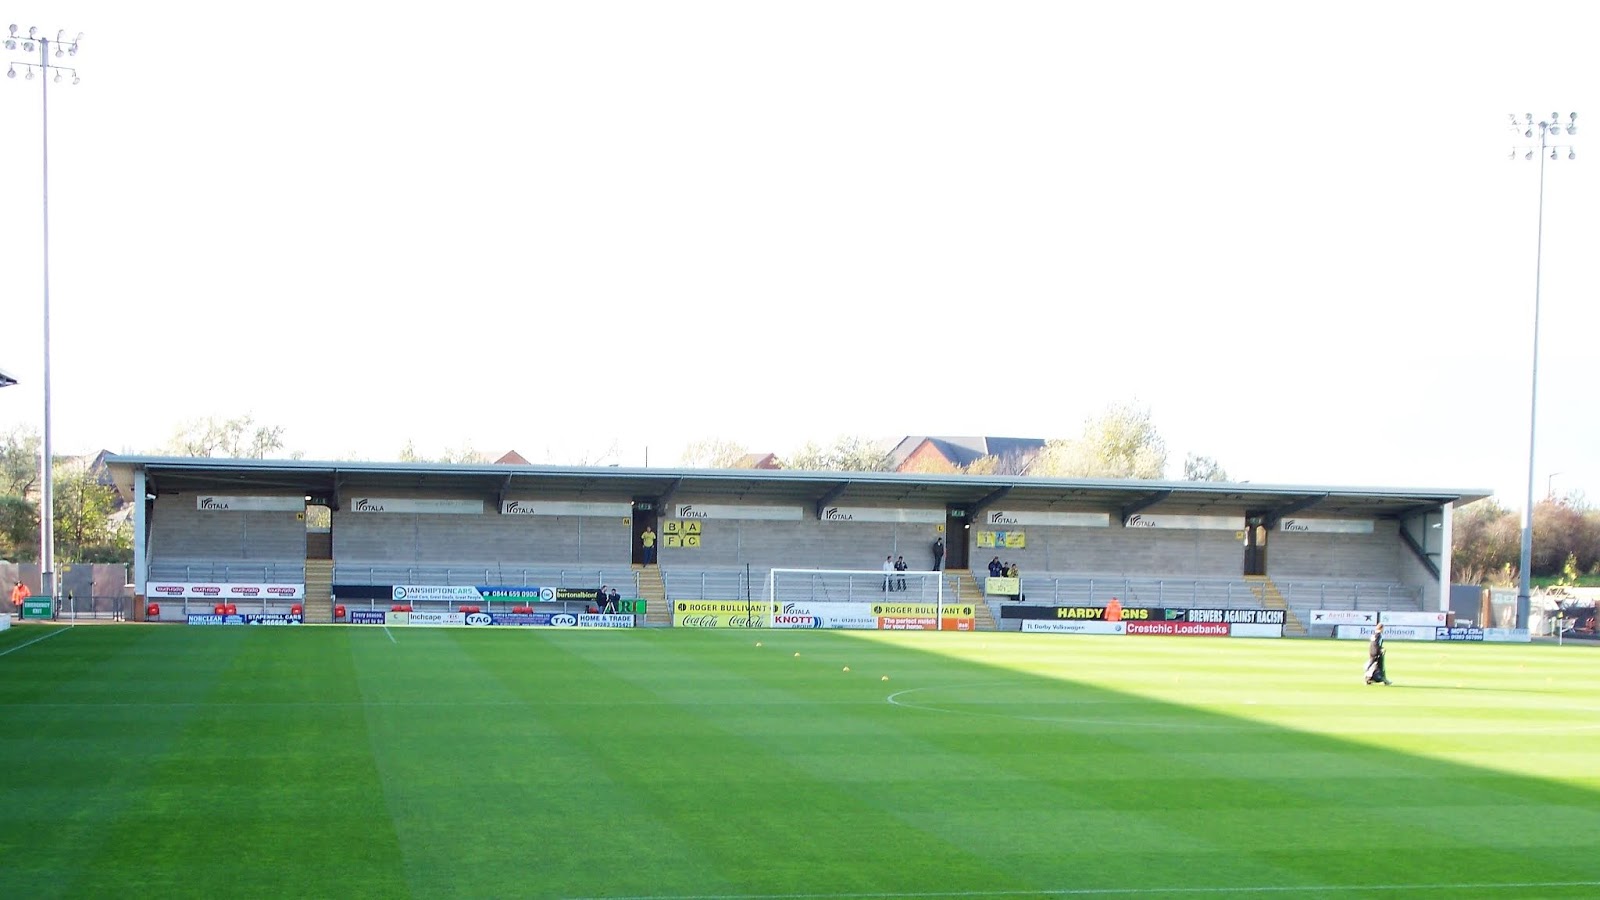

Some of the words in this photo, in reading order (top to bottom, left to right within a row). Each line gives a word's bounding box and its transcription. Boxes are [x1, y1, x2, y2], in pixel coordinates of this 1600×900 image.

[689, 523, 696, 531] A
[669, 537, 674, 545] F
[689, 537, 695, 545] C
[410, 613, 441, 621] Inchcape
[1058, 608, 1103, 618] HARDY
[1189, 610, 1222, 622] BREWERS
[1225, 611, 1255, 623] AGAINST
[1257, 611, 1283, 623] RACISM
[469, 616, 490, 624] TAG
[553, 617, 574, 625] TAG
[1128, 624, 1172, 633] Crestchic
[1175, 624, 1227, 634] Loadbanks
